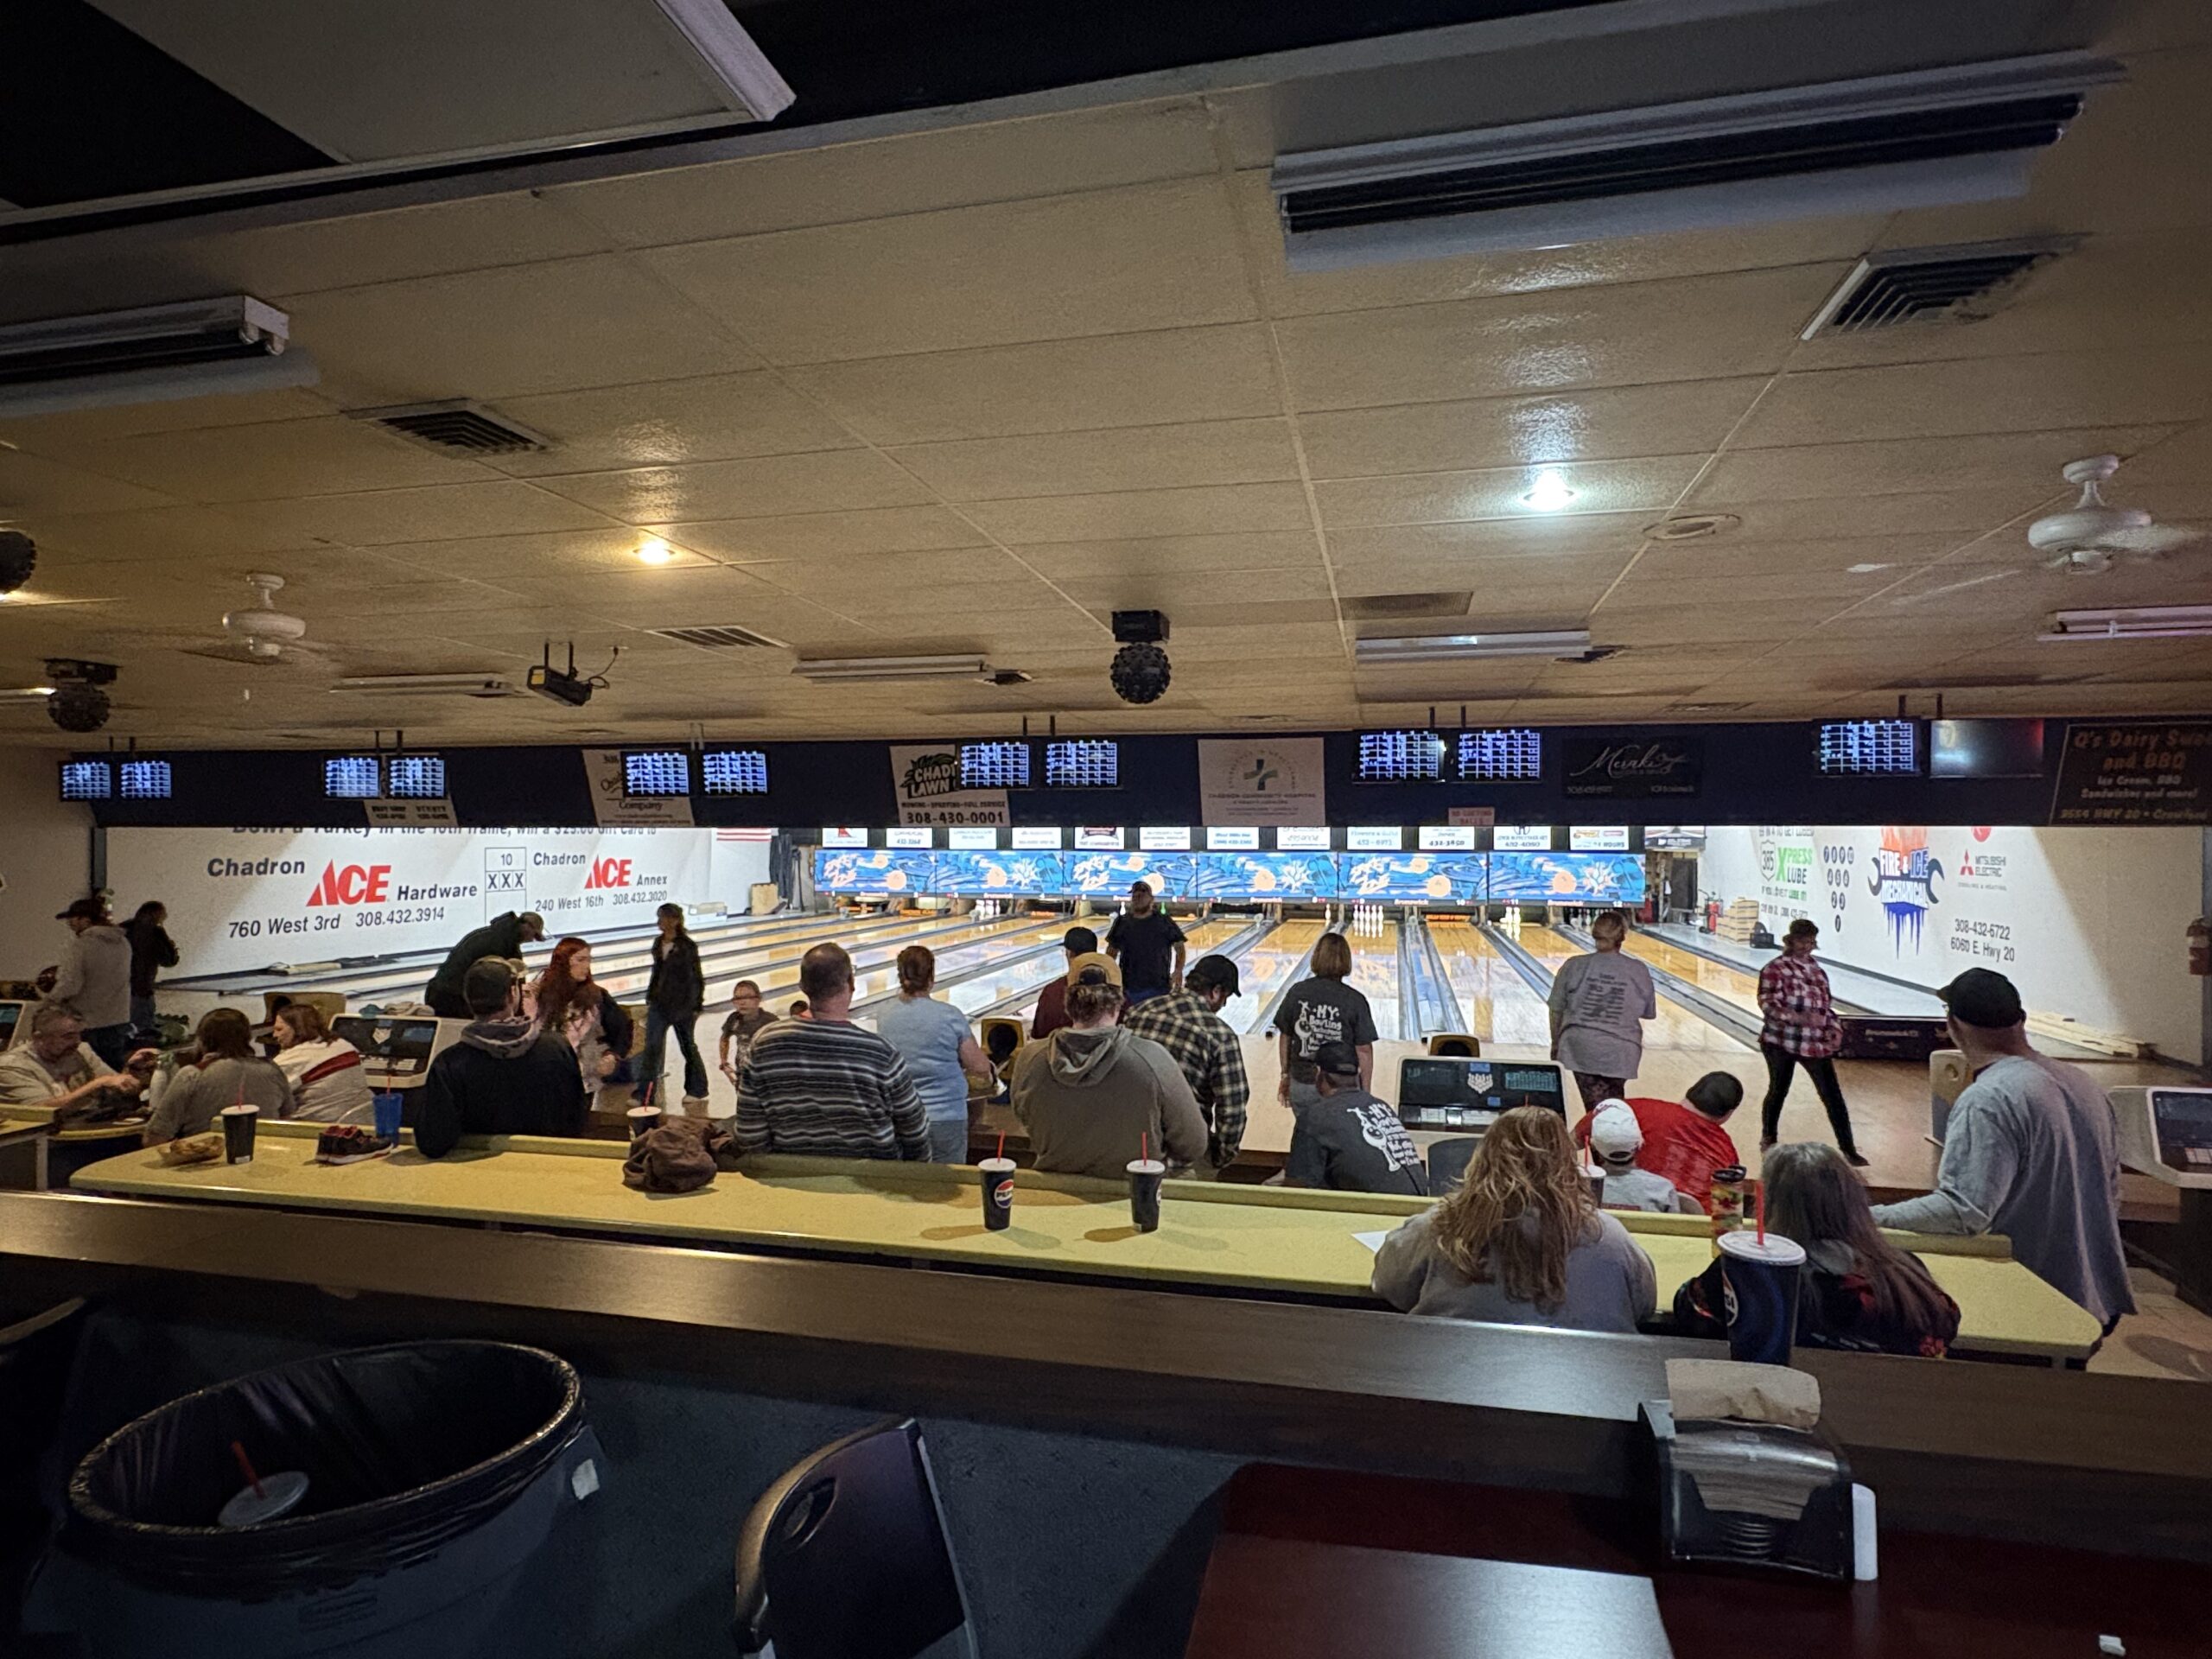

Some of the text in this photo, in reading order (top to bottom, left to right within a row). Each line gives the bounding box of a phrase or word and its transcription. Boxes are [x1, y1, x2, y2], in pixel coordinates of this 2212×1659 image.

[2109, 731, 2158, 750] Dairy
[2103, 753, 2136, 769] and
[911, 779, 950, 797] LAWN
[907, 811, 1004, 824] 308-430-0001
[207, 857, 305, 877] Chadron
[500, 854, 512, 866] 10
[533, 852, 587, 866] Chadron
[1880, 849, 1900, 876] FIRE
[1910, 849, 1929, 879] ICE
[584, 854, 632, 889] ACE
[636, 874, 668, 887] Annex
[1787, 867, 1808, 884] LUBE
[306, 858, 391, 906] ACE
[397, 882, 478, 901] Hardware
[535, 891, 667, 912] 240 West 16th 308.432.3020
[1881, 880, 1929, 908] MECHANICAL
[229, 906, 445, 938] 760 West 3rd 308.432.3914
[1955, 918, 2011, 940] 308-432-6722
[1983, 943, 2000, 963] Hwy
[2004, 946, 2015, 962] 20
